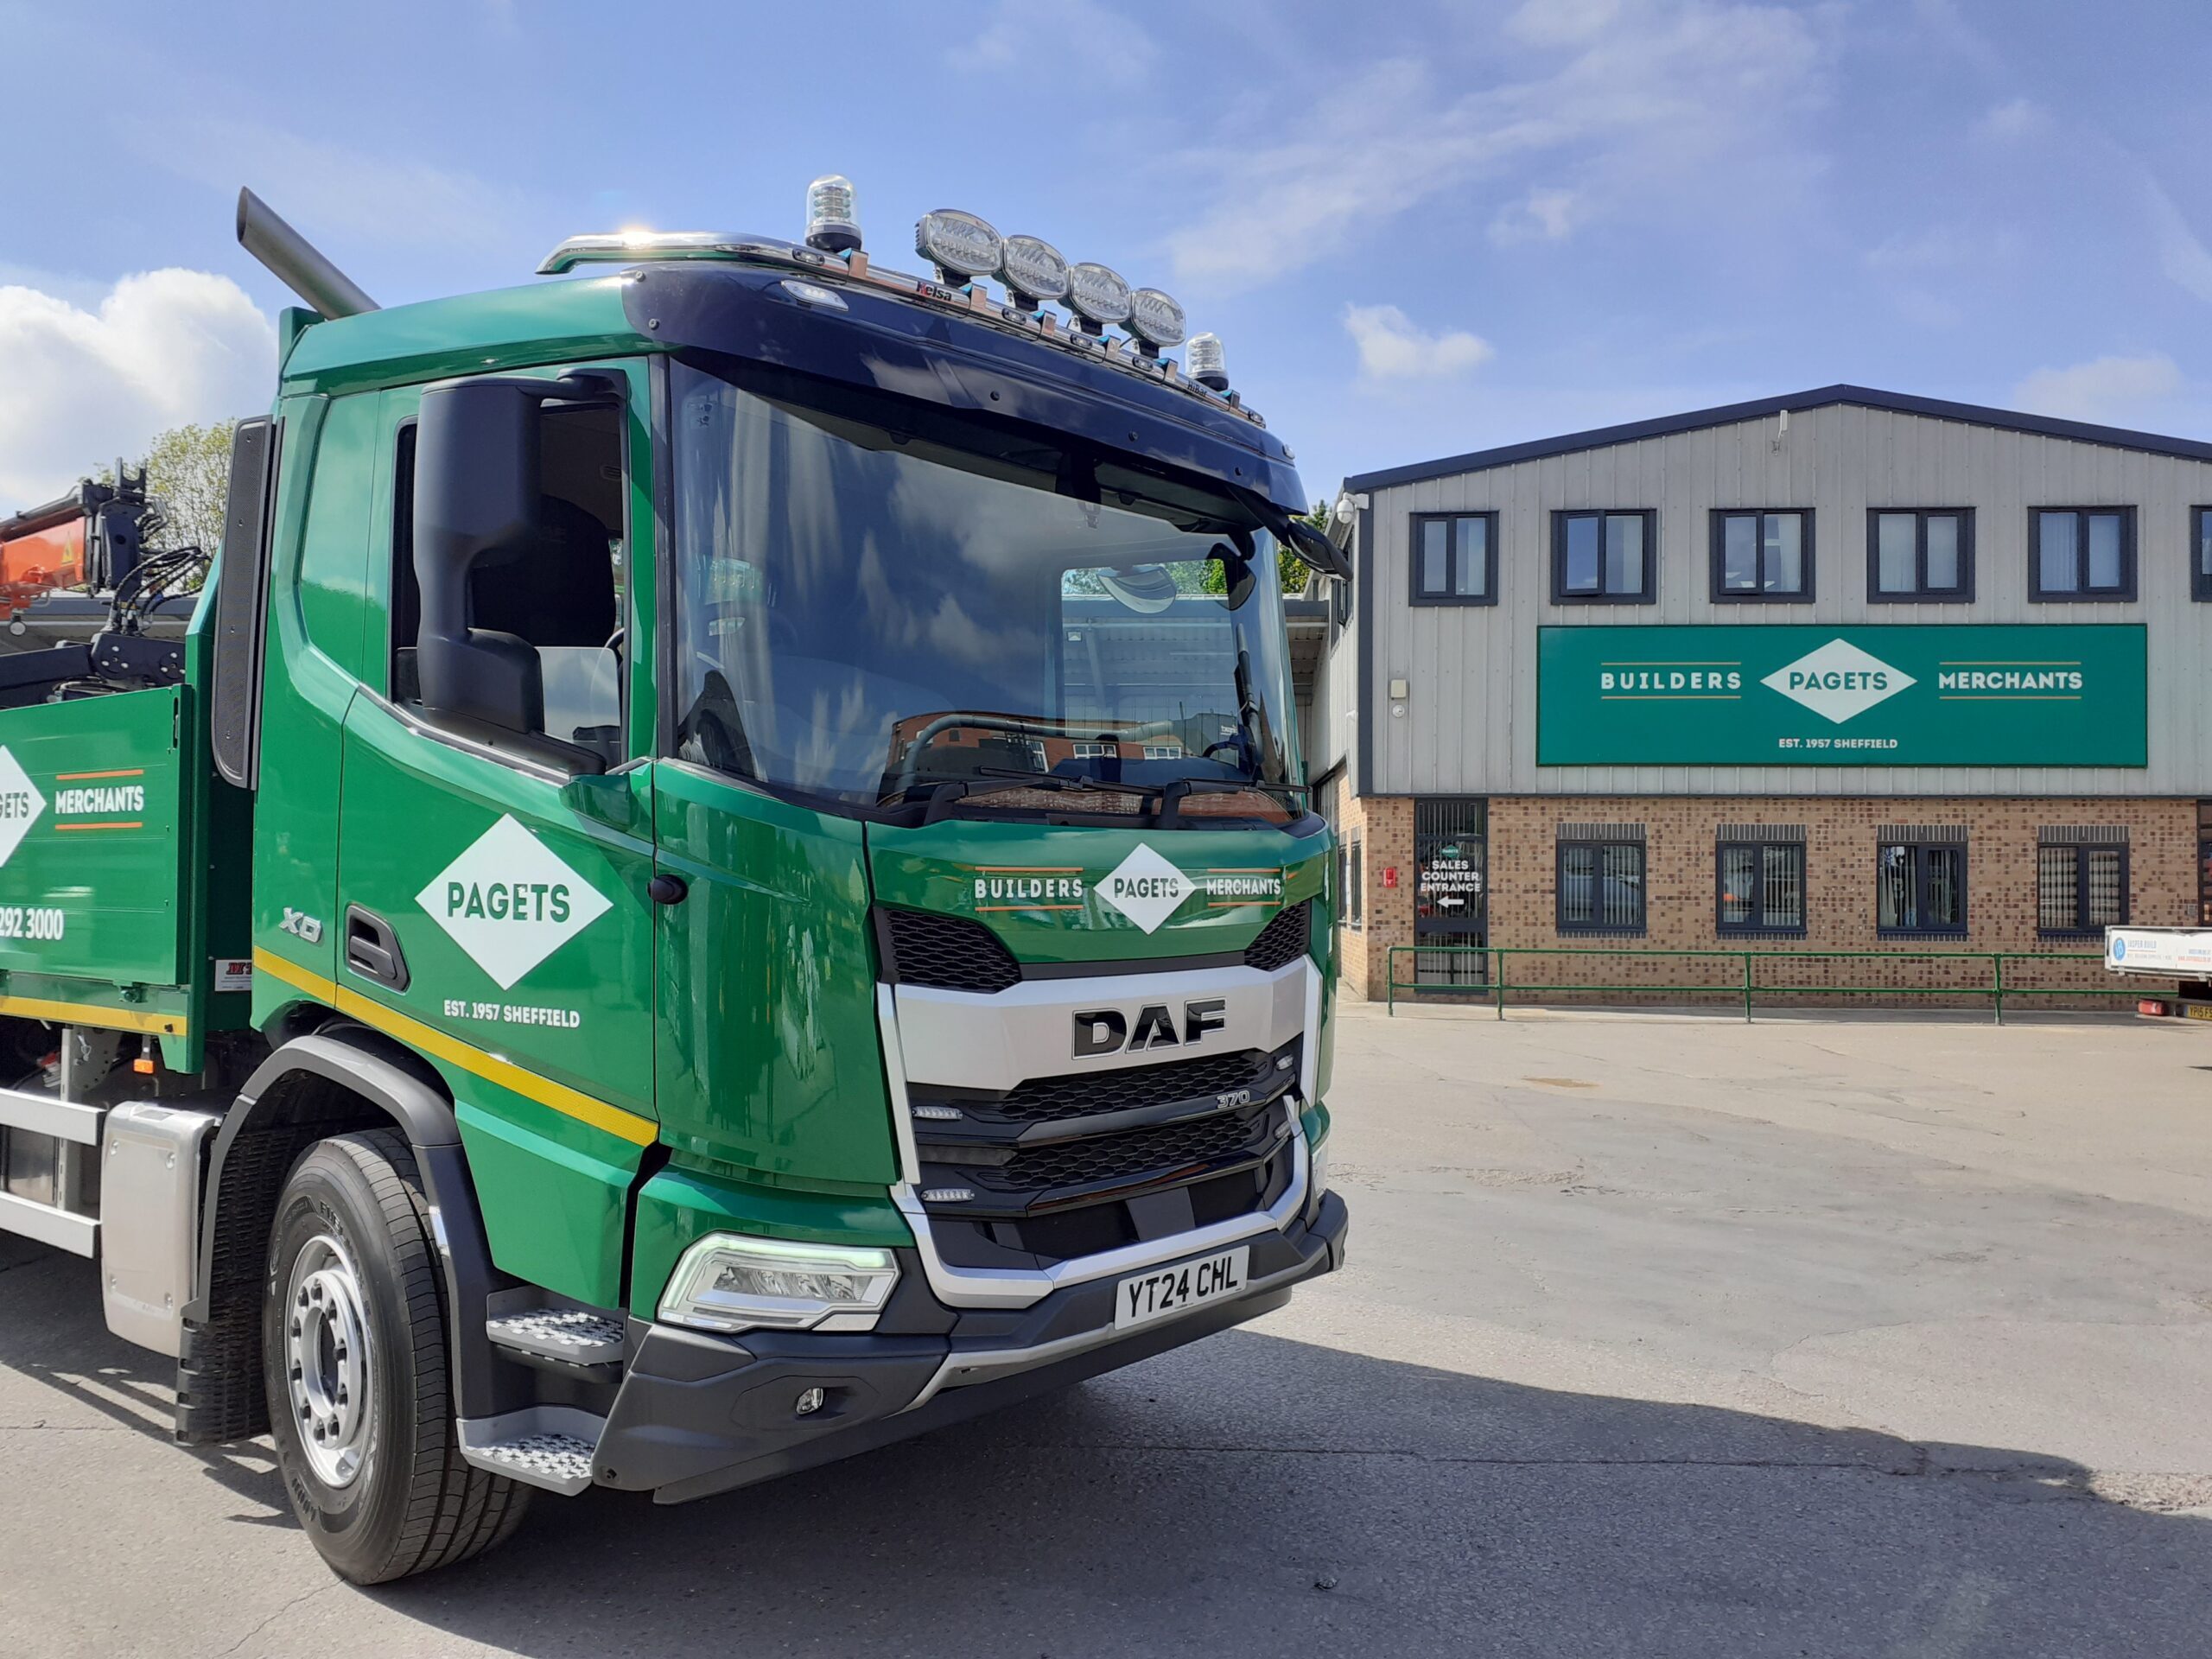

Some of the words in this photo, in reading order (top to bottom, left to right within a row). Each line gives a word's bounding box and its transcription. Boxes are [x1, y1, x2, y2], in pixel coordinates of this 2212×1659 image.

[916, 281, 952, 302] Kelsa
[1187, 380, 1208, 397] HiBar
[1600, 671, 1741, 690] BUILDERS
[1789, 671, 1888, 690] PAGETS
[1938, 671, 2082, 690] MERCHANTS
[1778, 739, 1803, 748] EST.
[1806, 739, 1831, 748] 1957
[1834, 739, 1898, 749] SHEFFIELD
[54, 785, 144, 814] MERCHANTS
[1432, 860, 1469, 870] SALES
[1421, 871, 1480, 881] COUNTER
[974, 879, 1083, 899] BUILDERS
[1114, 877, 1179, 899] PAGETS
[1205, 879, 1281, 896] MERCHANTS
[1420, 882, 1481, 892] ENTRANCE
[448, 881, 570, 923] PAGETS
[25, 907, 64, 940] 3000
[443, 1000, 469, 1018] EST.
[472, 1002, 500, 1020] 1957
[503, 1005, 581, 1028] SHEFFIELD
[1071, 996, 1226, 1060] DAF
[1217, 1090, 1250, 1109] 370
[1129, 1268, 1190, 1318] YT24
[1197, 1256, 1238, 1297] CHL
